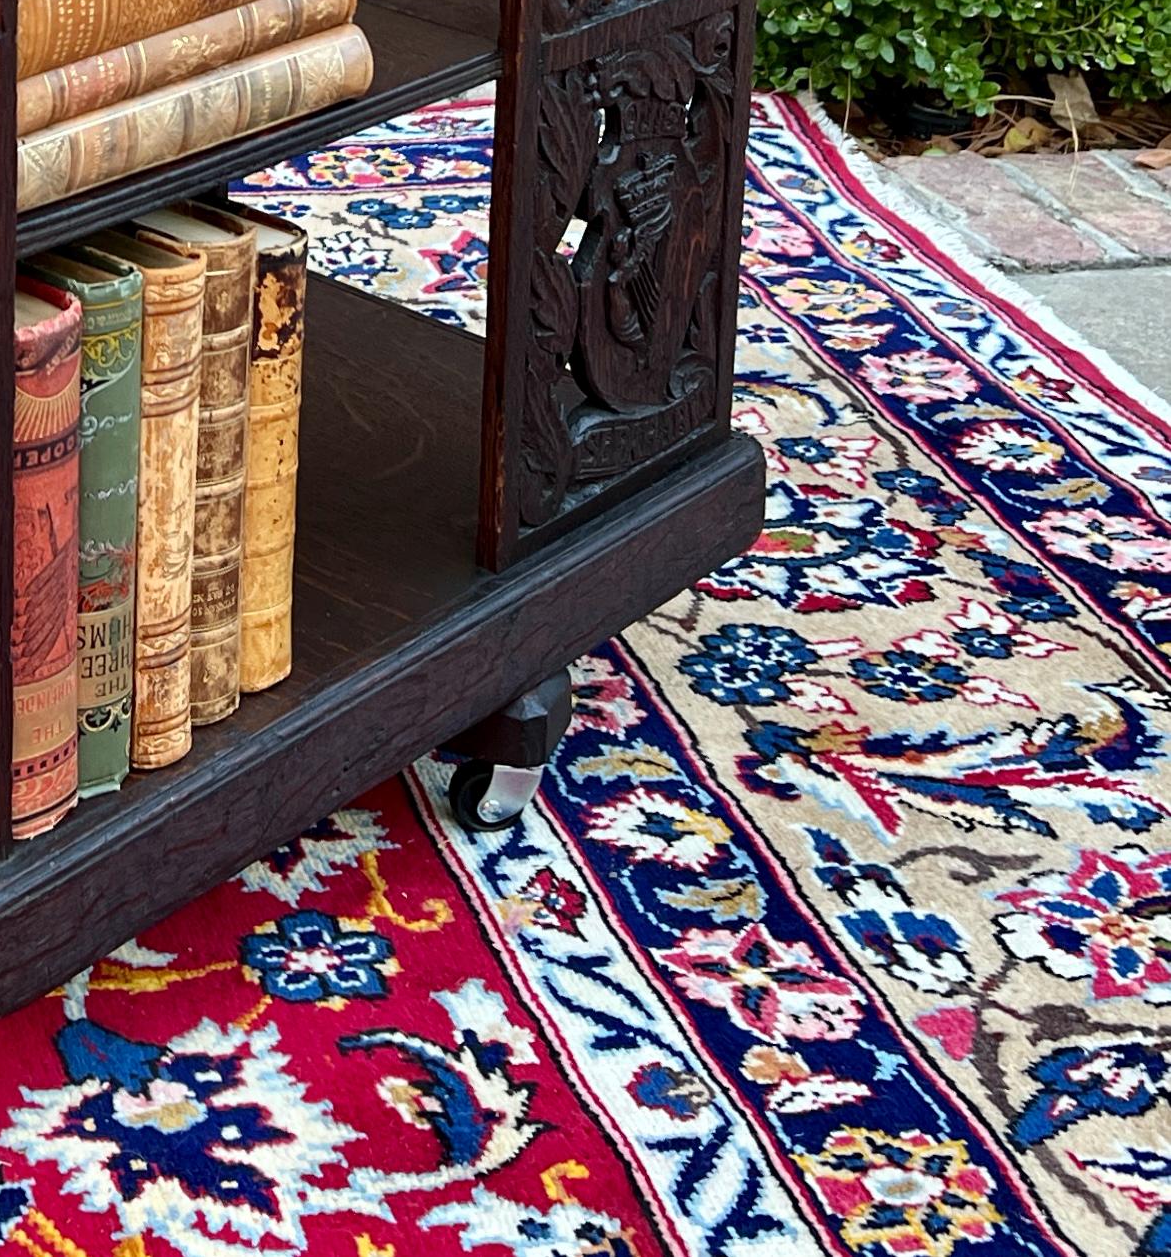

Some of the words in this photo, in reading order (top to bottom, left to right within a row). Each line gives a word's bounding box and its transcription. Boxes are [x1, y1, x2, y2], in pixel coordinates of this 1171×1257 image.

[14, 437, 76, 468] OOPE
[80, 642, 132, 680] HREE
[94, 672, 128, 699] THE
[31, 718, 63, 746] THE
